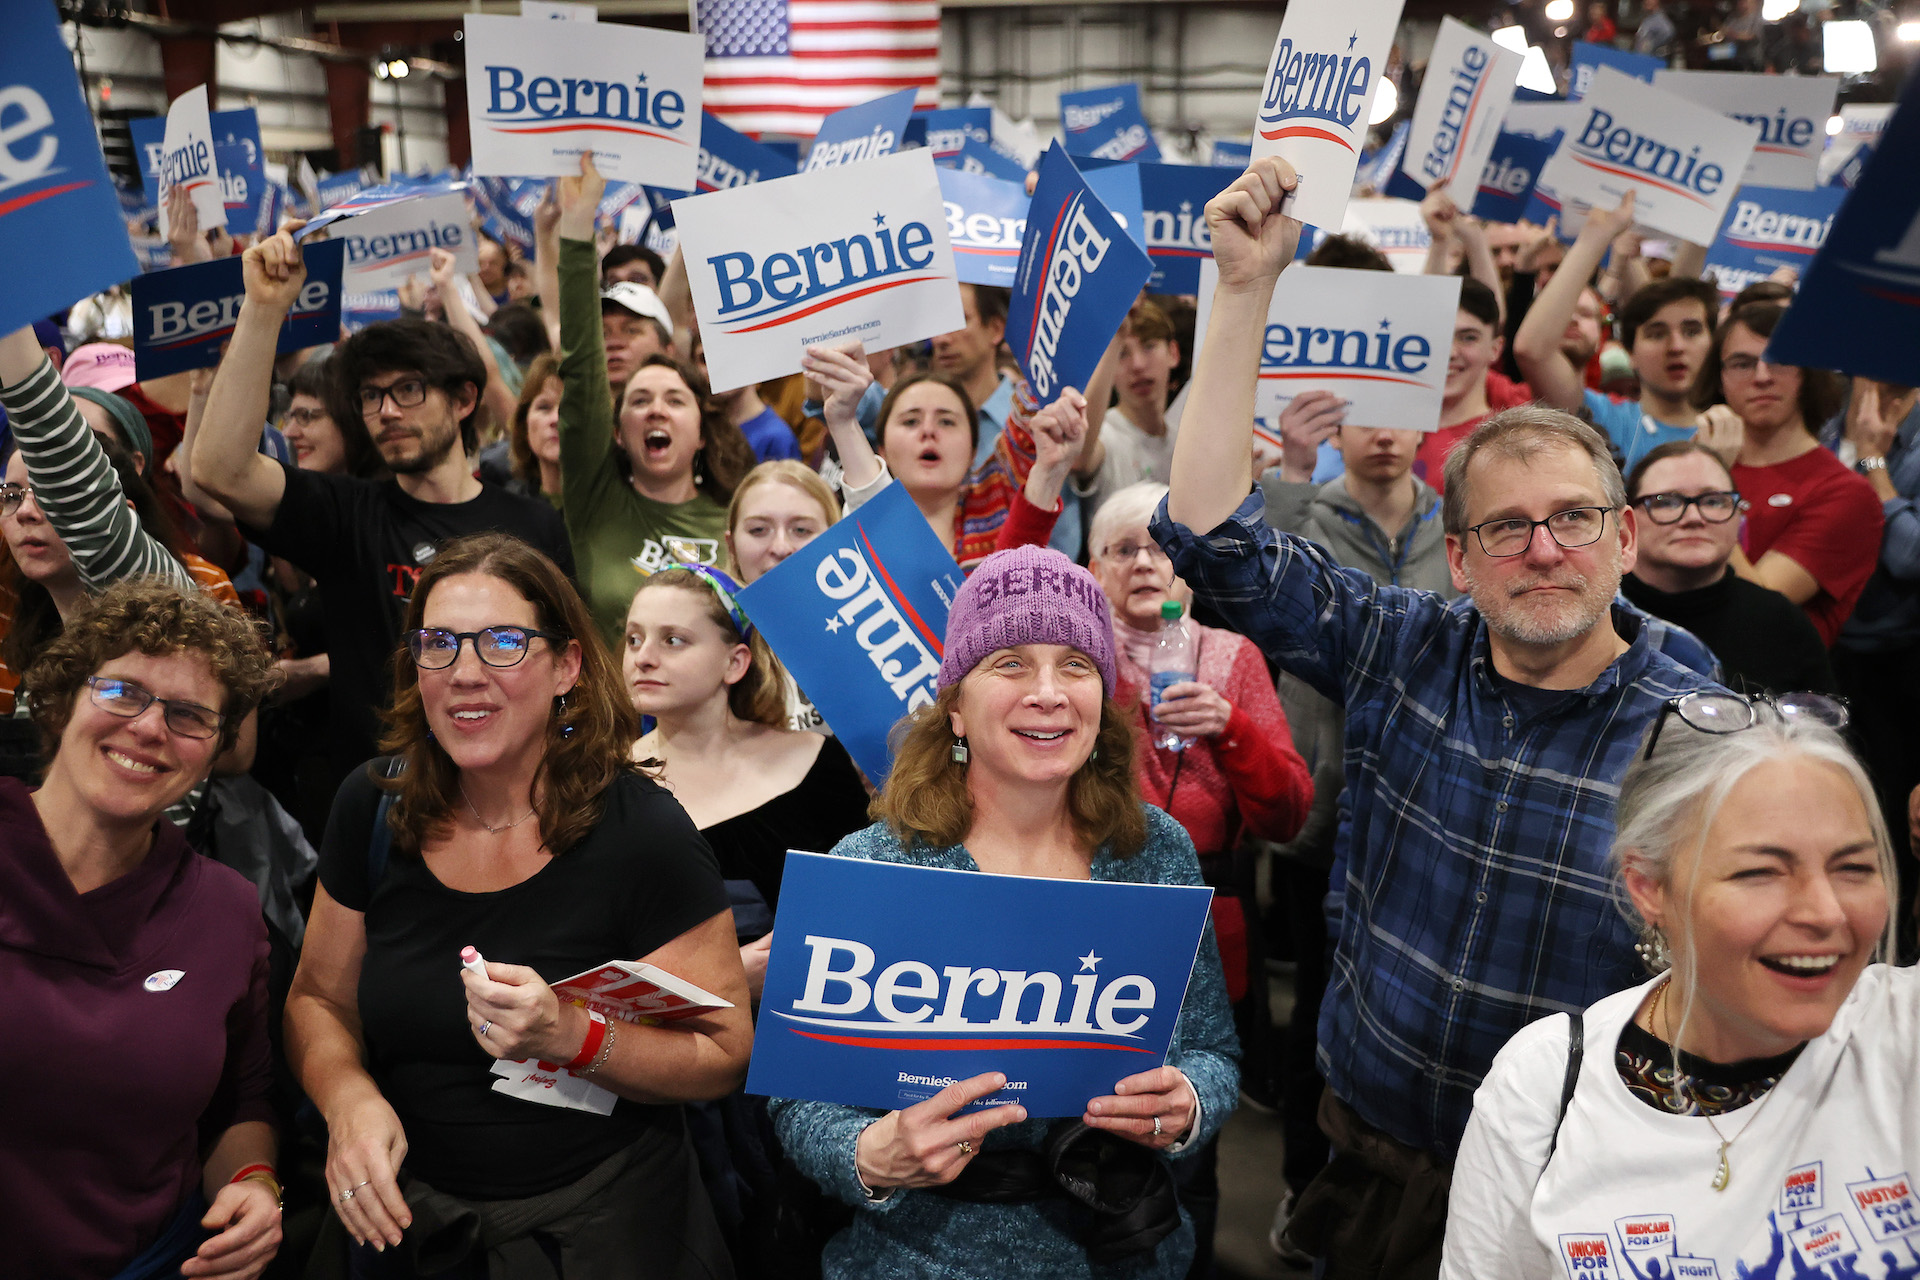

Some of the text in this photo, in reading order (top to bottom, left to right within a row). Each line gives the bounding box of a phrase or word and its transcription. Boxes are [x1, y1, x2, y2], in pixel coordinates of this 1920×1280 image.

[1263, 30, 1371, 127] Bernie
[485, 65, 685, 130] Bernie
[1423, 45, 1489, 179] Bernie
[1577, 106, 1723, 196] Bernie
[1729, 201, 1837, 247] Berni
[345, 220, 463, 263] Bernie
[707, 211, 934, 315] Bernie
[149, 280, 330, 339] Bere
[1030, 203, 1112, 398] Bernie
[1262, 317, 1430, 374] ernie
[792, 933, 1157, 1034] Bernie
[521, 1073, 557, 1089] Enjoy!
[897, 1072, 1028, 1090] BernieSacom
[1786, 1183, 1816, 1198] FOR
[1855, 1181, 1909, 1210] JUSTICE
[1787, 1195, 1813, 1208] ALL
[1872, 1198, 1913, 1218] FOR
[1625, 1221, 1670, 1235] MEDICARE
[1809, 1223, 1828, 1237] PAY
[1883, 1212, 1920, 1234] ALL
[1567, 1240, 1607, 1258] UNIONS
[1627, 1234, 1669, 1246] FOR ALL
[1804, 1230, 1841, 1251] EQUITY
[1813, 1244, 1840, 1259] NOW
[1570, 1256, 1609, 1270] FOR
[1678, 1265, 1713, 1277] FIGHT
